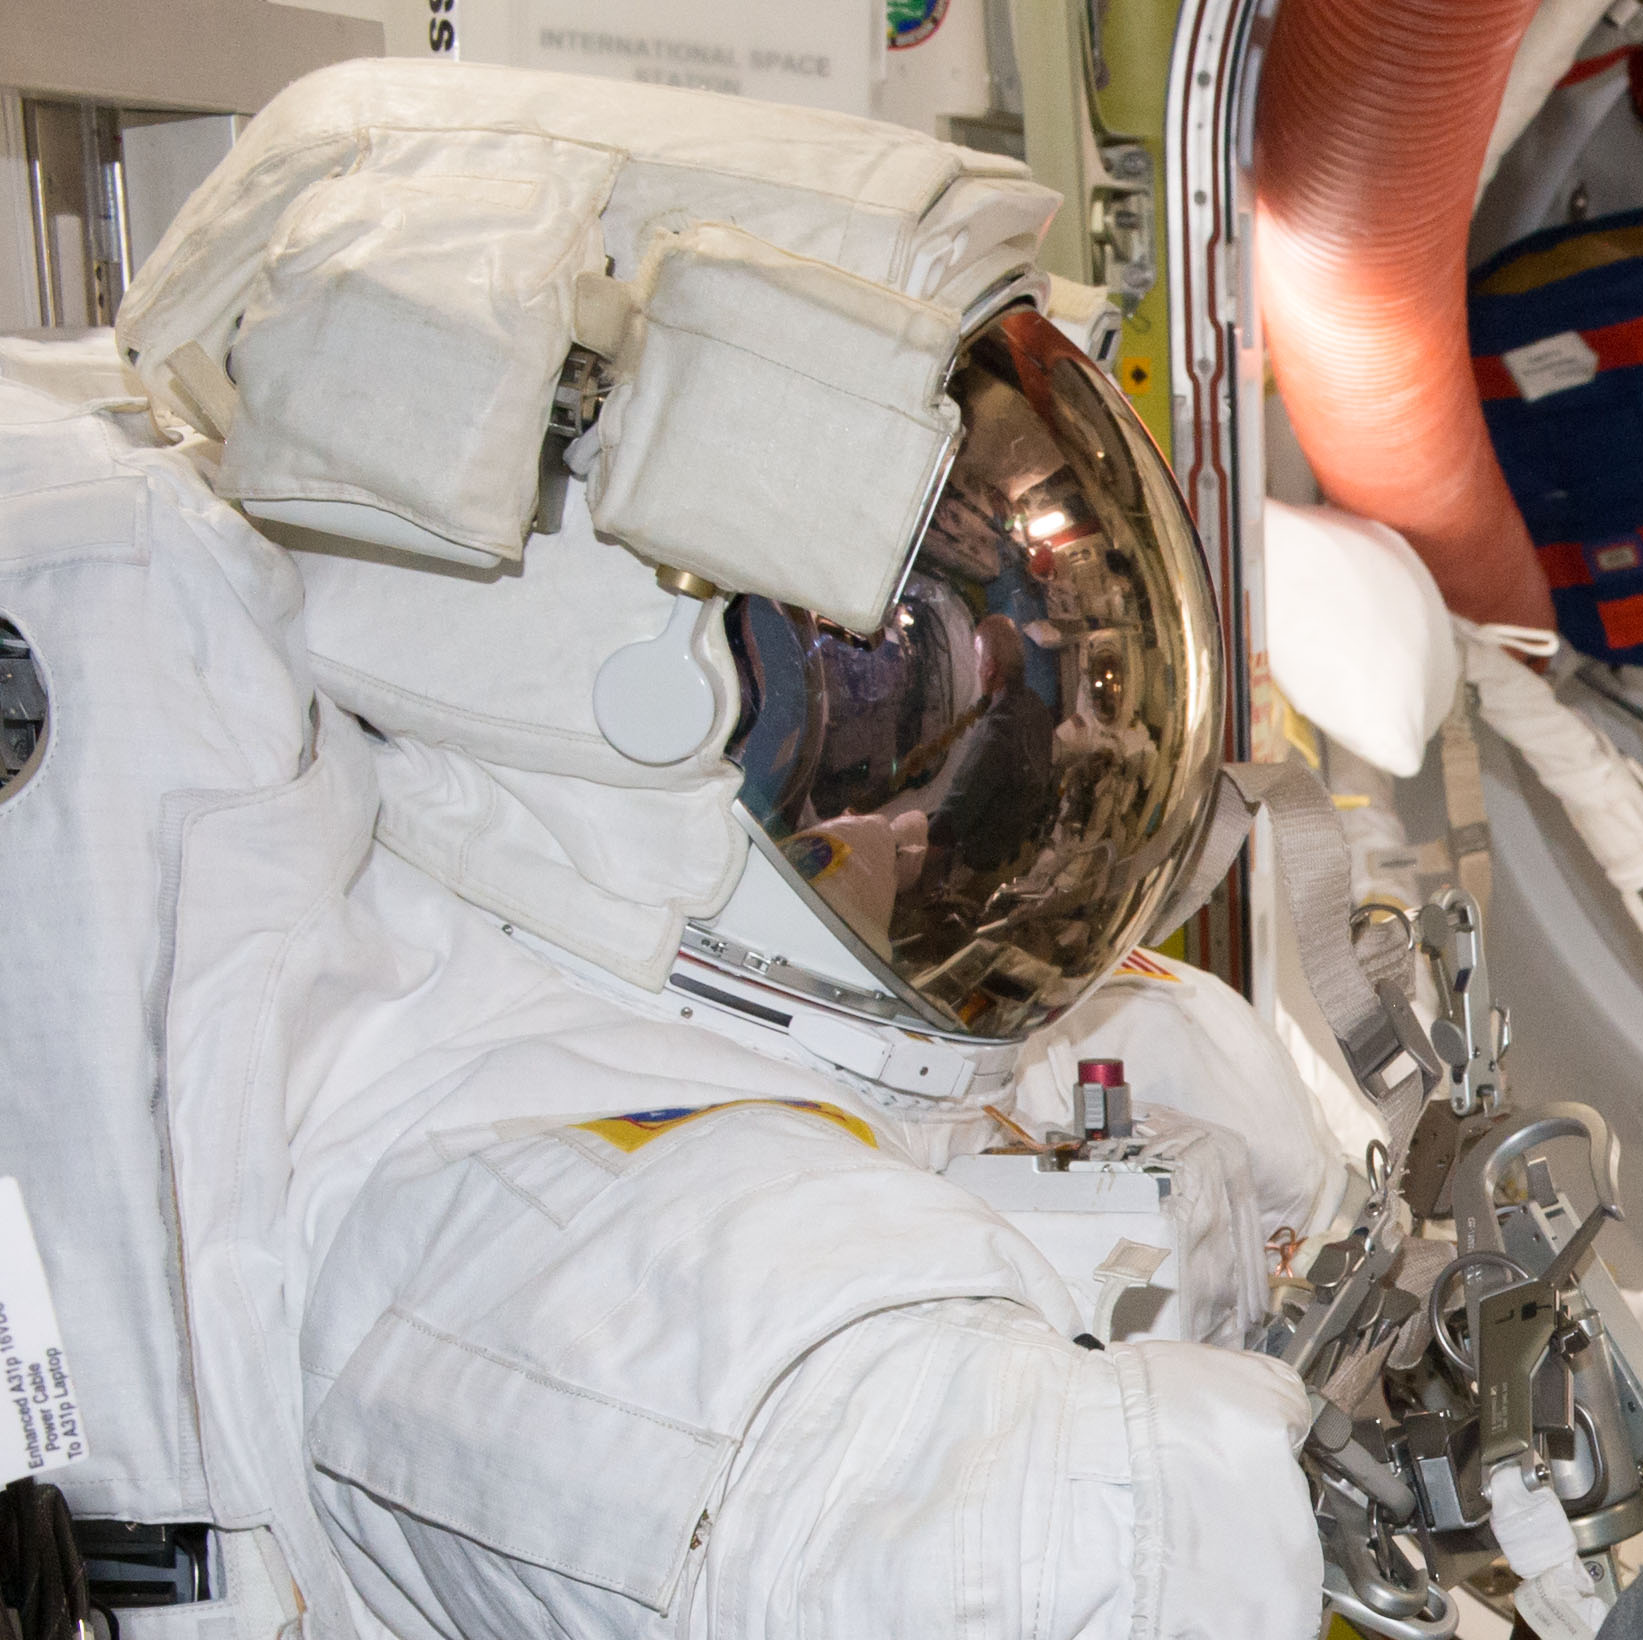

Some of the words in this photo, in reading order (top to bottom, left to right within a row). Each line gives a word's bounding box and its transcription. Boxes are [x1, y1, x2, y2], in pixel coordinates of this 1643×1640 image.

[541, 28, 738, 67] INTERNATIONAL
[748, 50, 832, 79] SPACE
[28, 1362, 49, 1404] Cable
[47, 1347, 69, 1398] Laptop
[14, 1397, 44, 1470] Enhanced
[40, 1408, 60, 1452] Power
[59, 1402, 76, 1438] A31p
[67, 1441, 82, 1460] To
